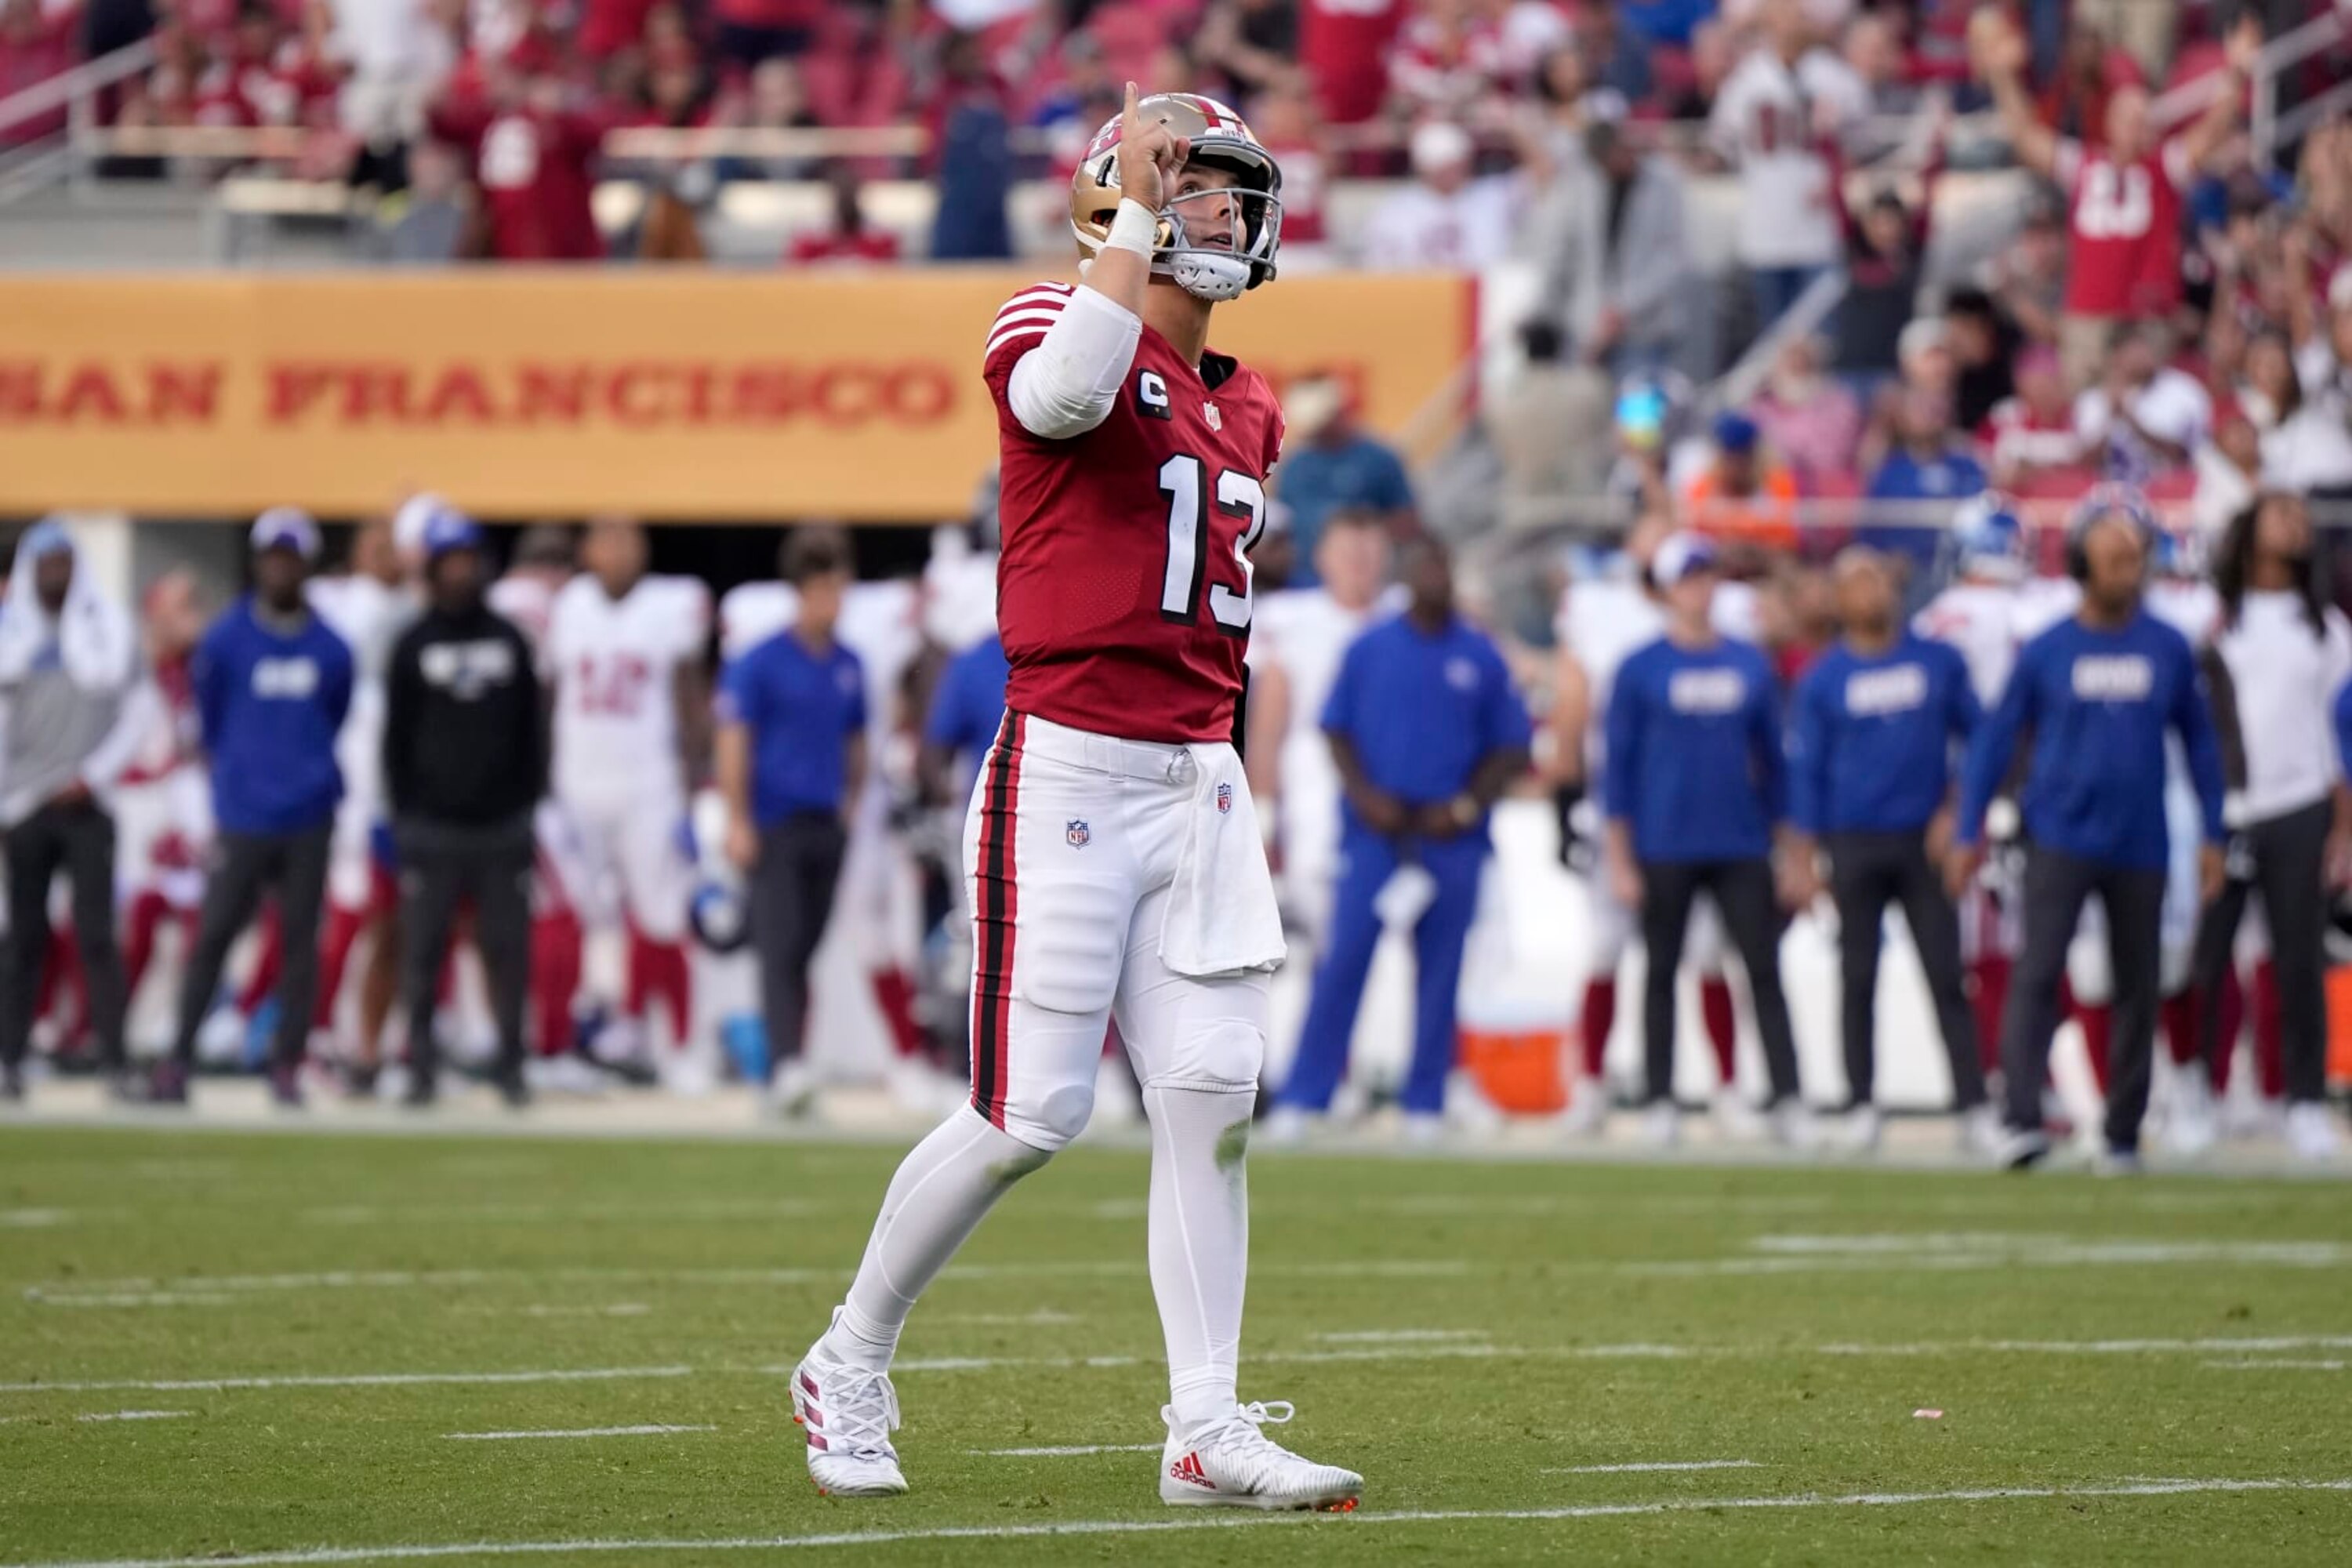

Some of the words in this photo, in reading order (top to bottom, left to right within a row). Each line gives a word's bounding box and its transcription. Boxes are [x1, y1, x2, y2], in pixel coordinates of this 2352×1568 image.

[265, 362, 955, 433] FRANCISCO
[1141, 372, 1168, 407] C
[1158, 452, 1265, 637] 13
[1170, 1467, 1217, 1489] adidas
